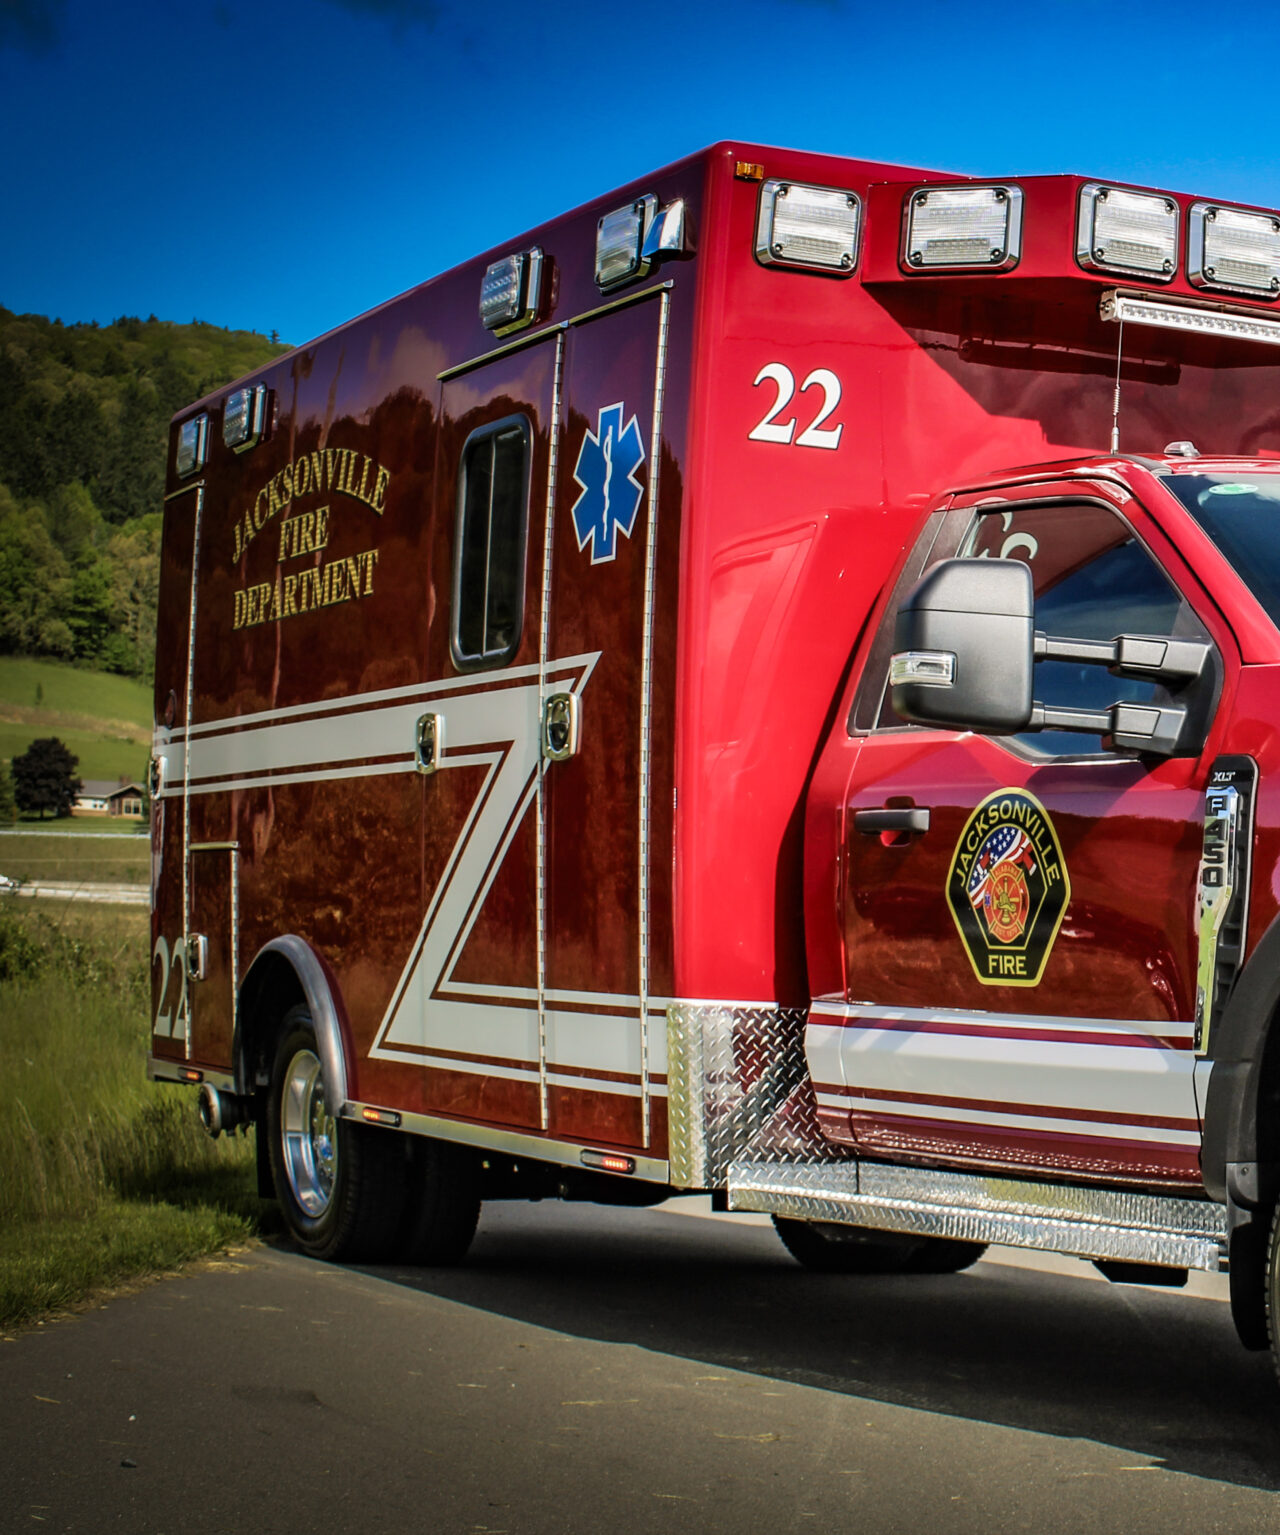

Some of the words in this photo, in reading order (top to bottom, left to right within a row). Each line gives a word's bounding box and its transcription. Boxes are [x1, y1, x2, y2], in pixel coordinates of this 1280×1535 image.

[748, 361, 844, 451] 22
[232, 448, 391, 565] JACKSONVILLE
[277, 504, 330, 562] FIRE
[232, 548, 379, 630] DEPARTMENT
[1212, 771, 1236, 782] XLT
[957, 800, 1060, 887] JACKSONVILLE
[152, 935, 192, 1040] 22
[988, 954, 1027, 975] FIRE
